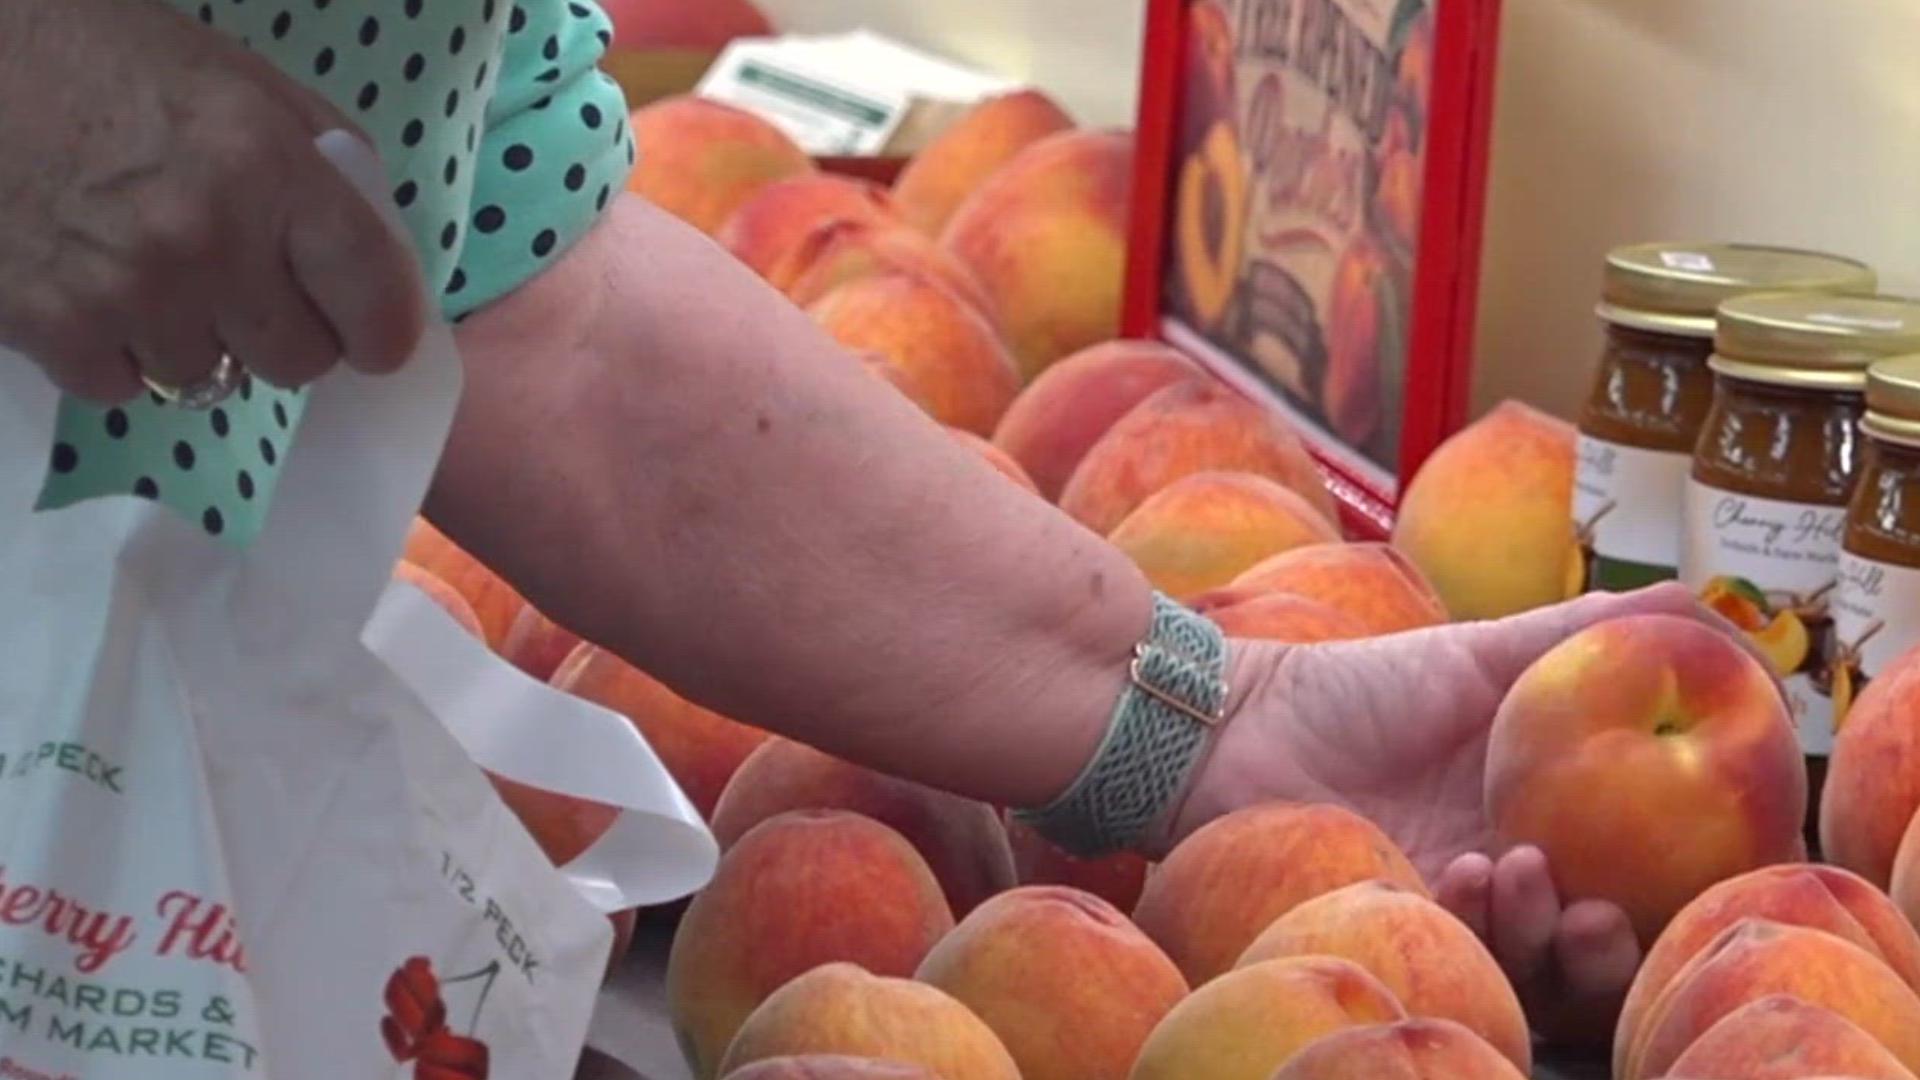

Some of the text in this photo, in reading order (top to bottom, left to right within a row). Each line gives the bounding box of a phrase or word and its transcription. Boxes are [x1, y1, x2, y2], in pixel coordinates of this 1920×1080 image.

[440, 851, 539, 985] 1/2 PECK
[201, 995, 235, 1026] &
[47, 1017, 258, 1070] MARKET
